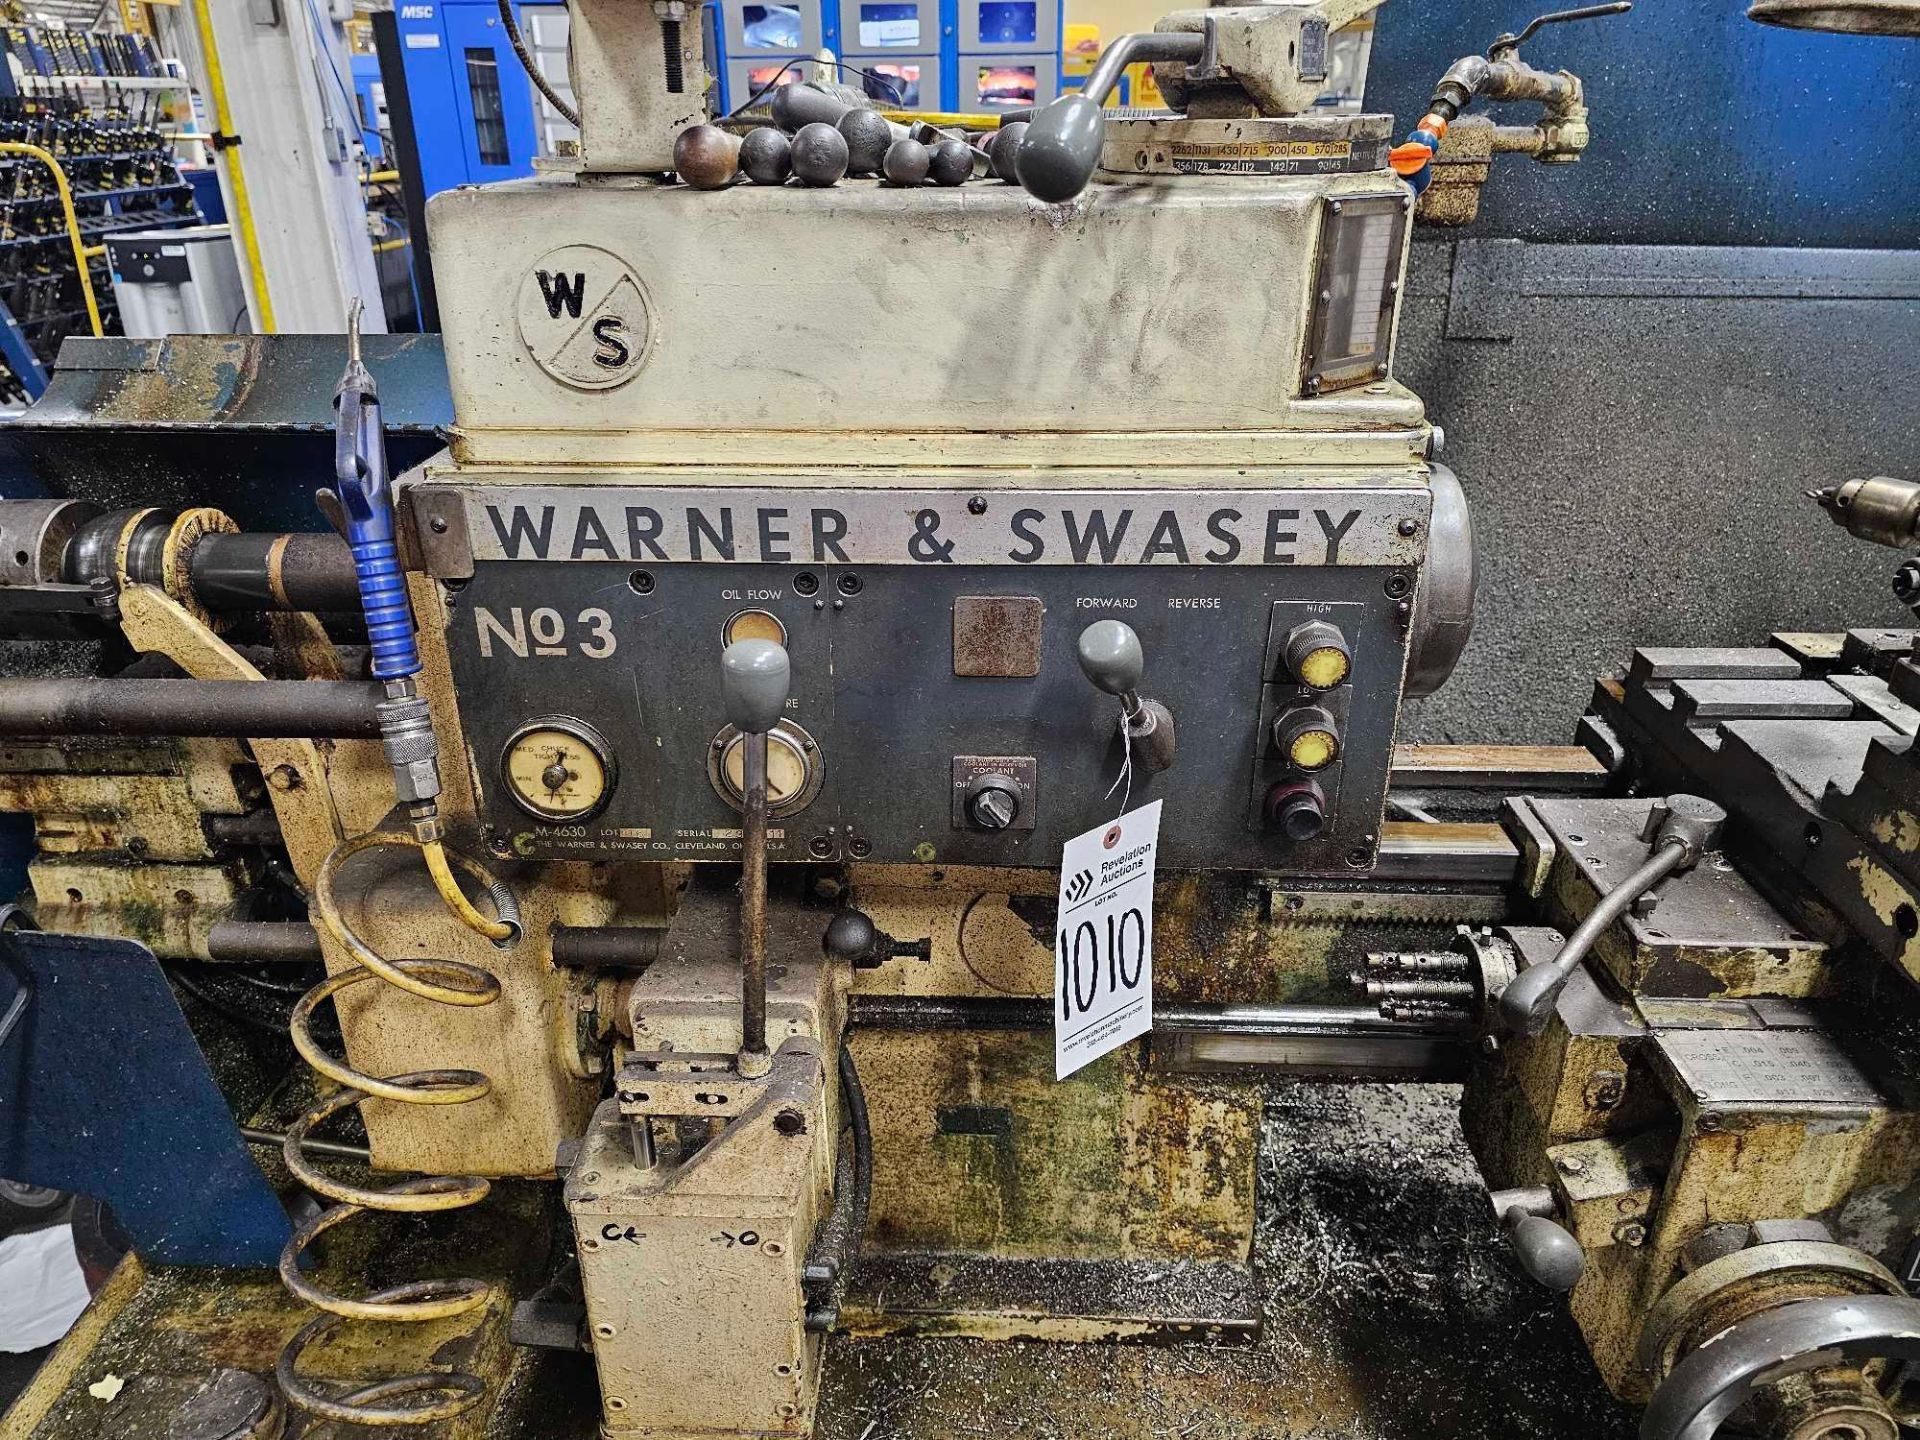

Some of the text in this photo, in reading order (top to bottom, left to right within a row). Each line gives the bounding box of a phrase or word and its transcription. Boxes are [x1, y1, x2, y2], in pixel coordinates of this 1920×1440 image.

[401, 6, 433, 18] MSC
[1217, 146, 1239, 155] 1430
[1243, 146, 1258, 155] 715
[1268, 145, 1287, 155] 900
[1291, 145, 1308, 155] 450
[1315, 144, 1331, 154] 570
[1175, 161, 1191, 171] 356
[1220, 162, 1238, 172] 224
[1242, 163, 1255, 172] 112
[1270, 162, 1286, 172] 142
[1289, 162, 1299, 172] 71
[1318, 161, 1329, 171] 90
[1332, 160, 1341, 170] 45
[535, 271, 585, 319] W
[593, 318, 629, 368] S
[486, 505, 1361, 563] WARNER & SWASEY
[722, 590, 782, 600] OIL FLOW
[1076, 598, 1221, 608] FORWARD REVERSE
[1306, 604, 1332, 613] HIGH
[578, 607, 617, 658] 3
[1297, 685, 1313, 694] LO
[535, 826, 586, 837] M-4630
[677, 829, 711, 837] SERIAL
[559, 841, 596, 849] WARNER
[600, 841, 607, 849] &
[1101, 843, 1151, 873] Revelation
[1100, 858, 1144, 887] Auctions
[1094, 895, 1107, 907] LOT
[1061, 908, 1145, 1021] 1010
[601, 1223, 622, 1241] C
